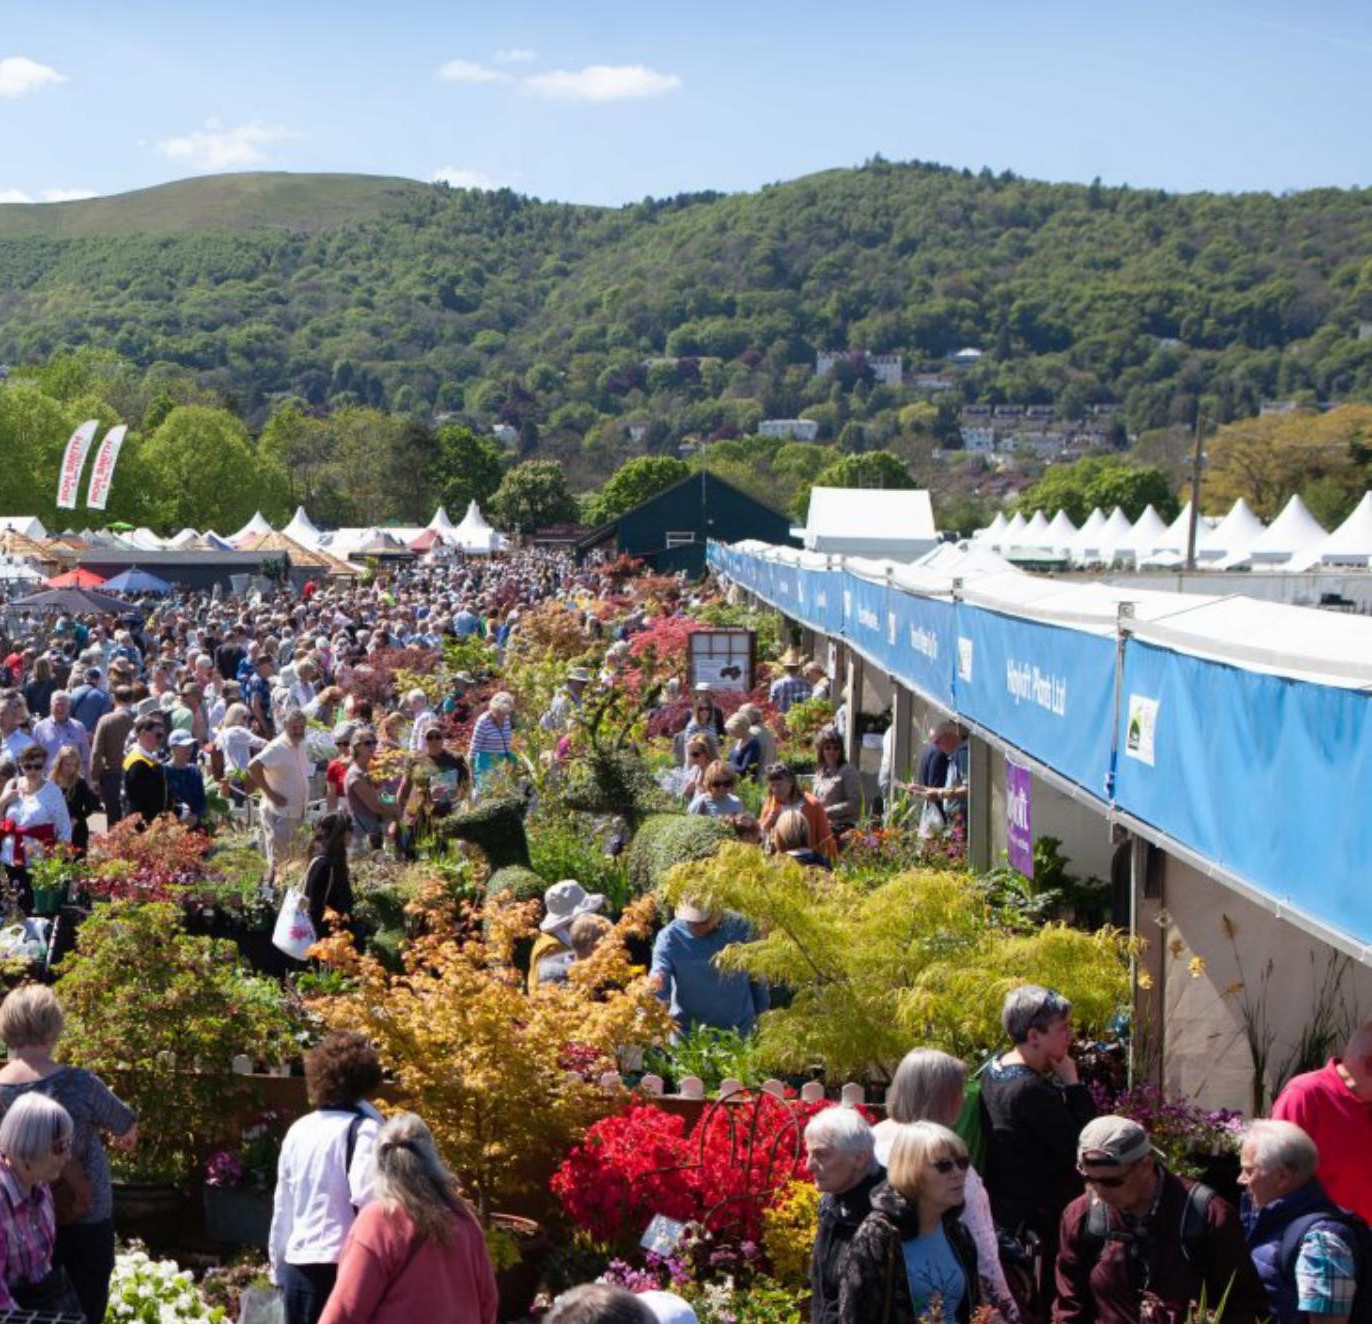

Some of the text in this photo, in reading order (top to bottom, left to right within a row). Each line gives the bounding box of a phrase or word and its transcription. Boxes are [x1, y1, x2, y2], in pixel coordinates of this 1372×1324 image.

[65, 435, 83, 473] SMITH
[96, 440, 112, 475] SMITH
[1052, 672, 1066, 716] Ltd
